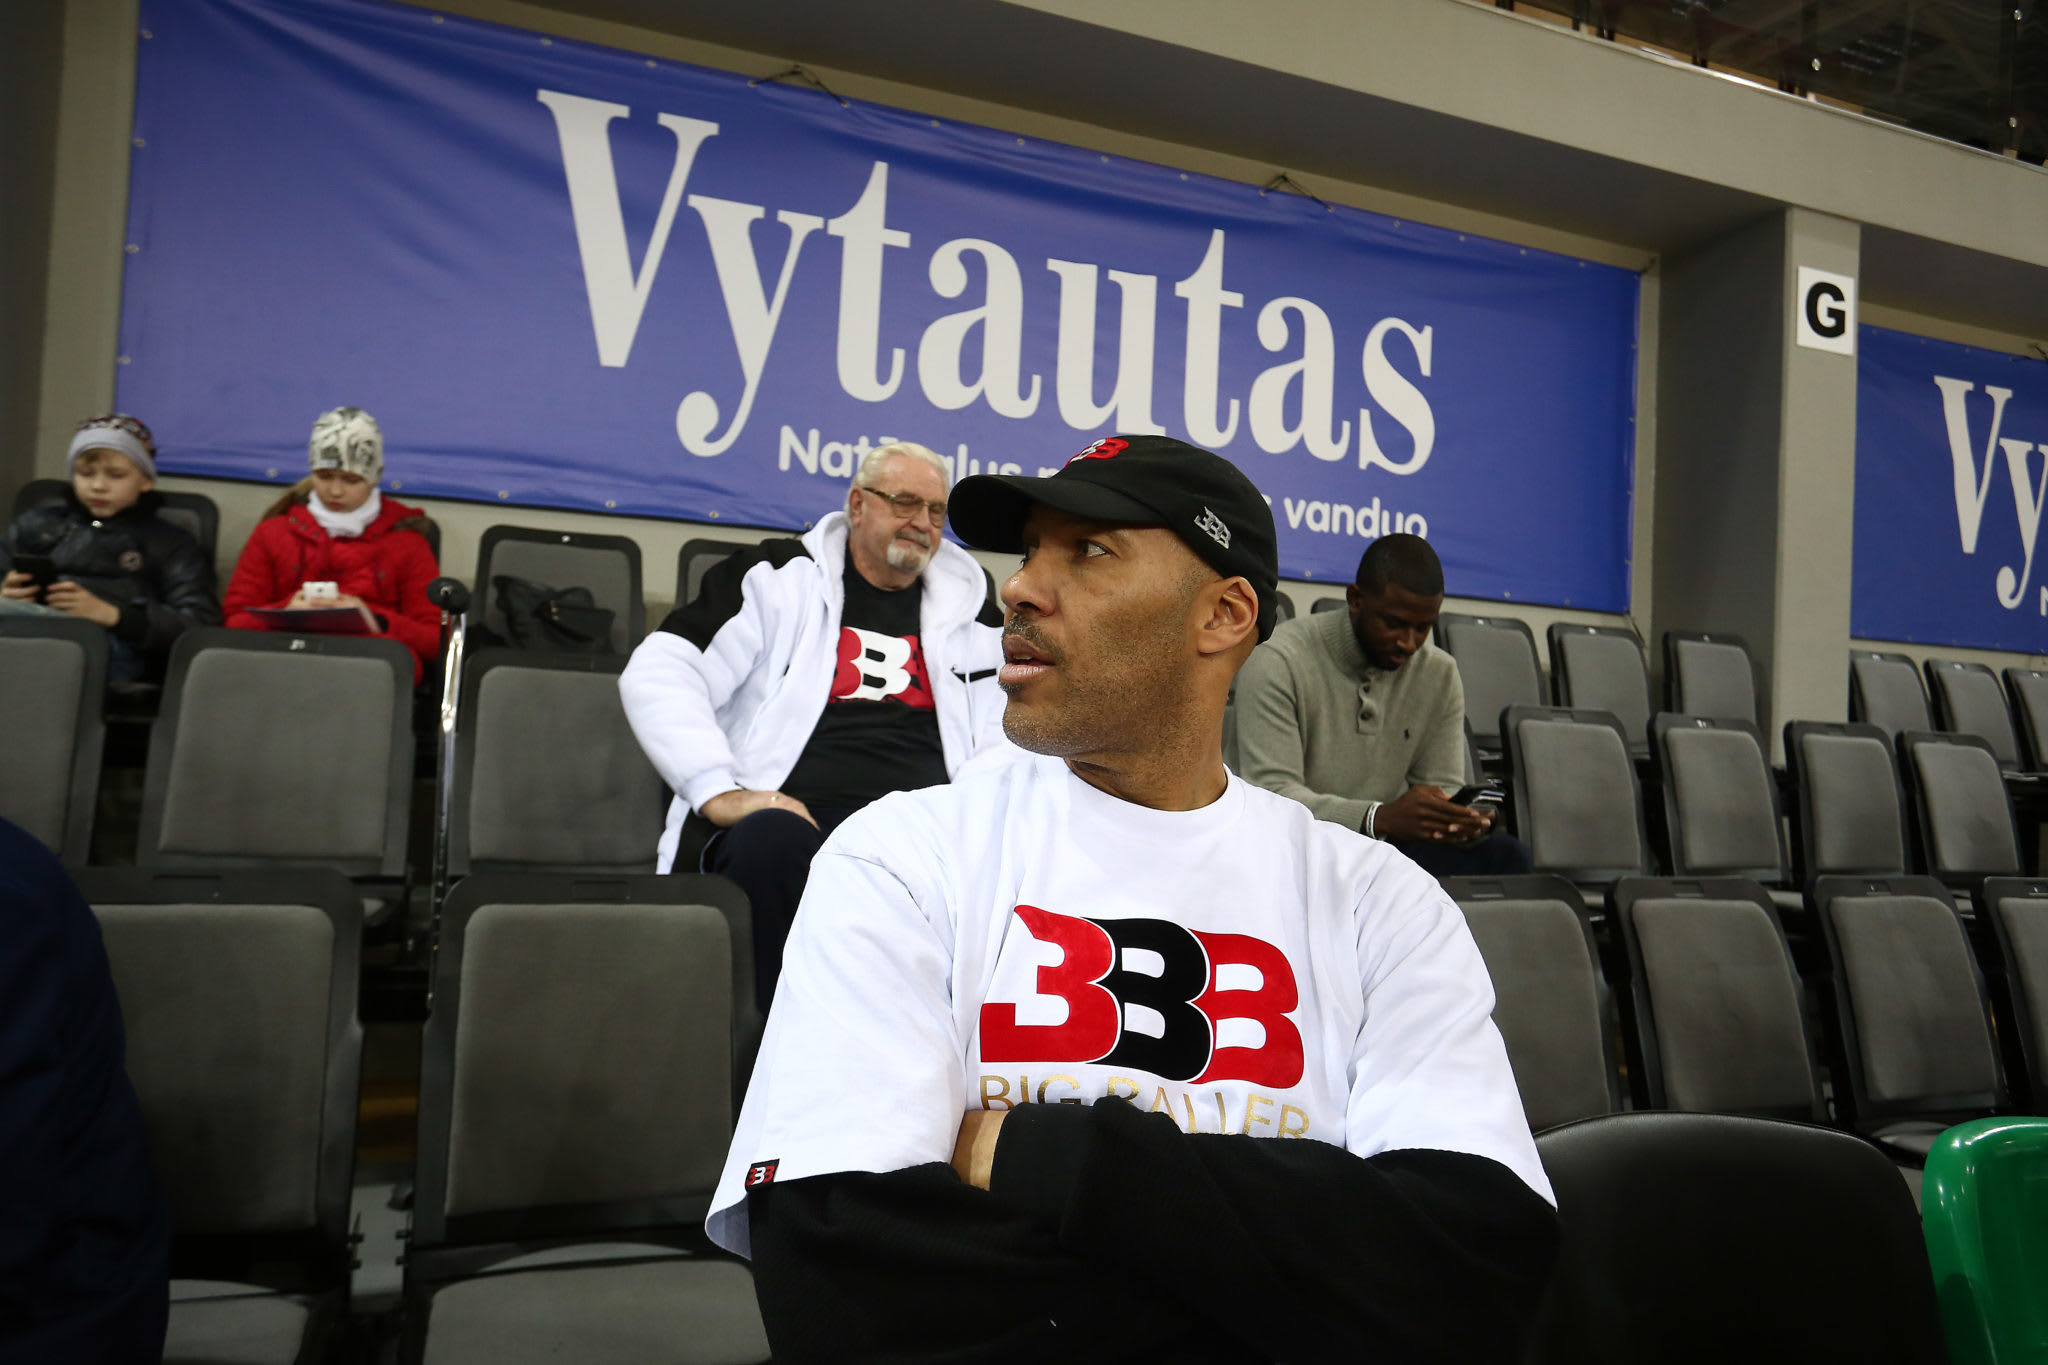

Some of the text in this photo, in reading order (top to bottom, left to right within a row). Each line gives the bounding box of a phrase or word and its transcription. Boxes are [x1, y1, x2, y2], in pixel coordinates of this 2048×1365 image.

[536, 89, 1436, 475] Vytautas
[1805, 281, 1846, 338] G
[980, 1074, 1082, 1111] BIG
